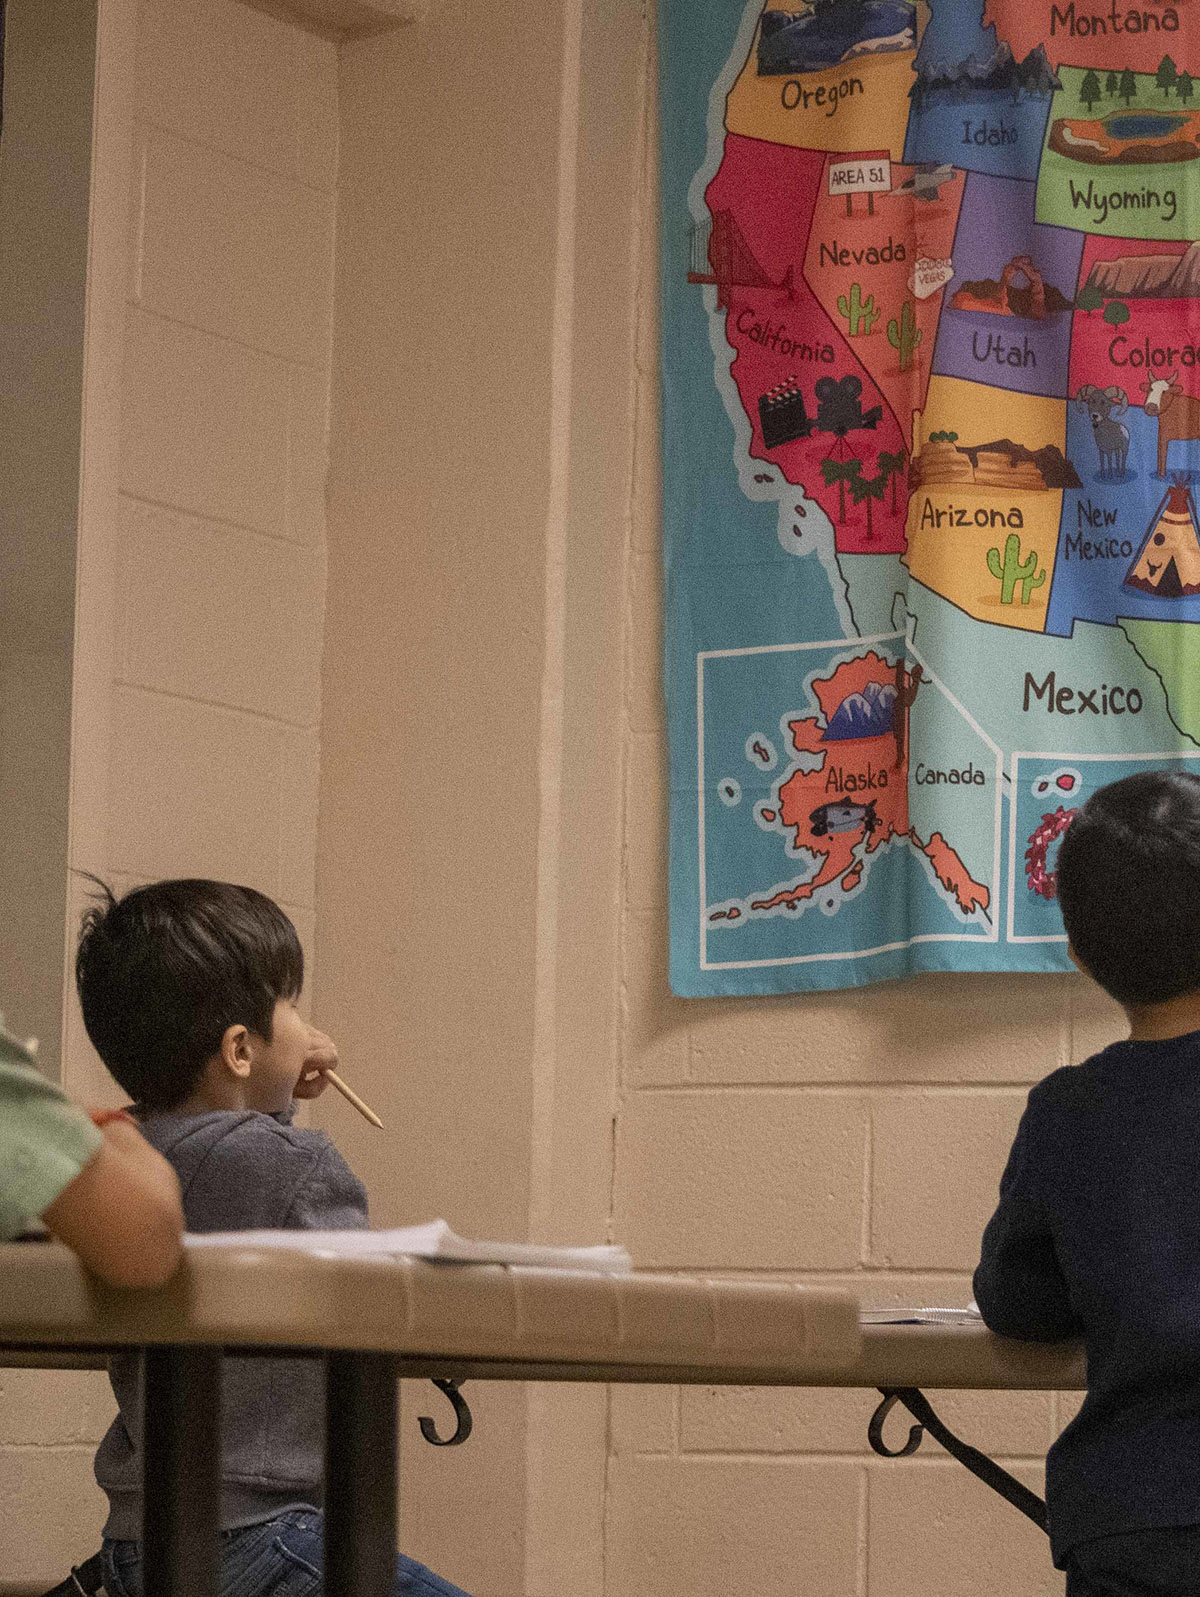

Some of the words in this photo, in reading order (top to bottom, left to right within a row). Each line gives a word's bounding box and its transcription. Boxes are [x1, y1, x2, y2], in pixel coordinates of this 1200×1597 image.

[1050, 3, 1179, 36] Montana
[781, 76, 864, 116] Oregon
[961, 121, 1018, 145] Idaho
[831, 169, 865, 185] AREA
[869, 167, 885, 183] 51
[1069, 180, 1177, 223] Wyoming
[819, 236, 906, 266] Nevada
[736, 308, 835, 363] California
[972, 331, 1037, 367] Utah
[921, 498, 1024, 530] Arizona
[1077, 500, 1118, 527] New
[1065, 533, 1133, 560] Mexico
[1022, 671, 1143, 716] Mexico
[825, 765, 889, 793] Alaska
[915, 762, 986, 786] Canada
